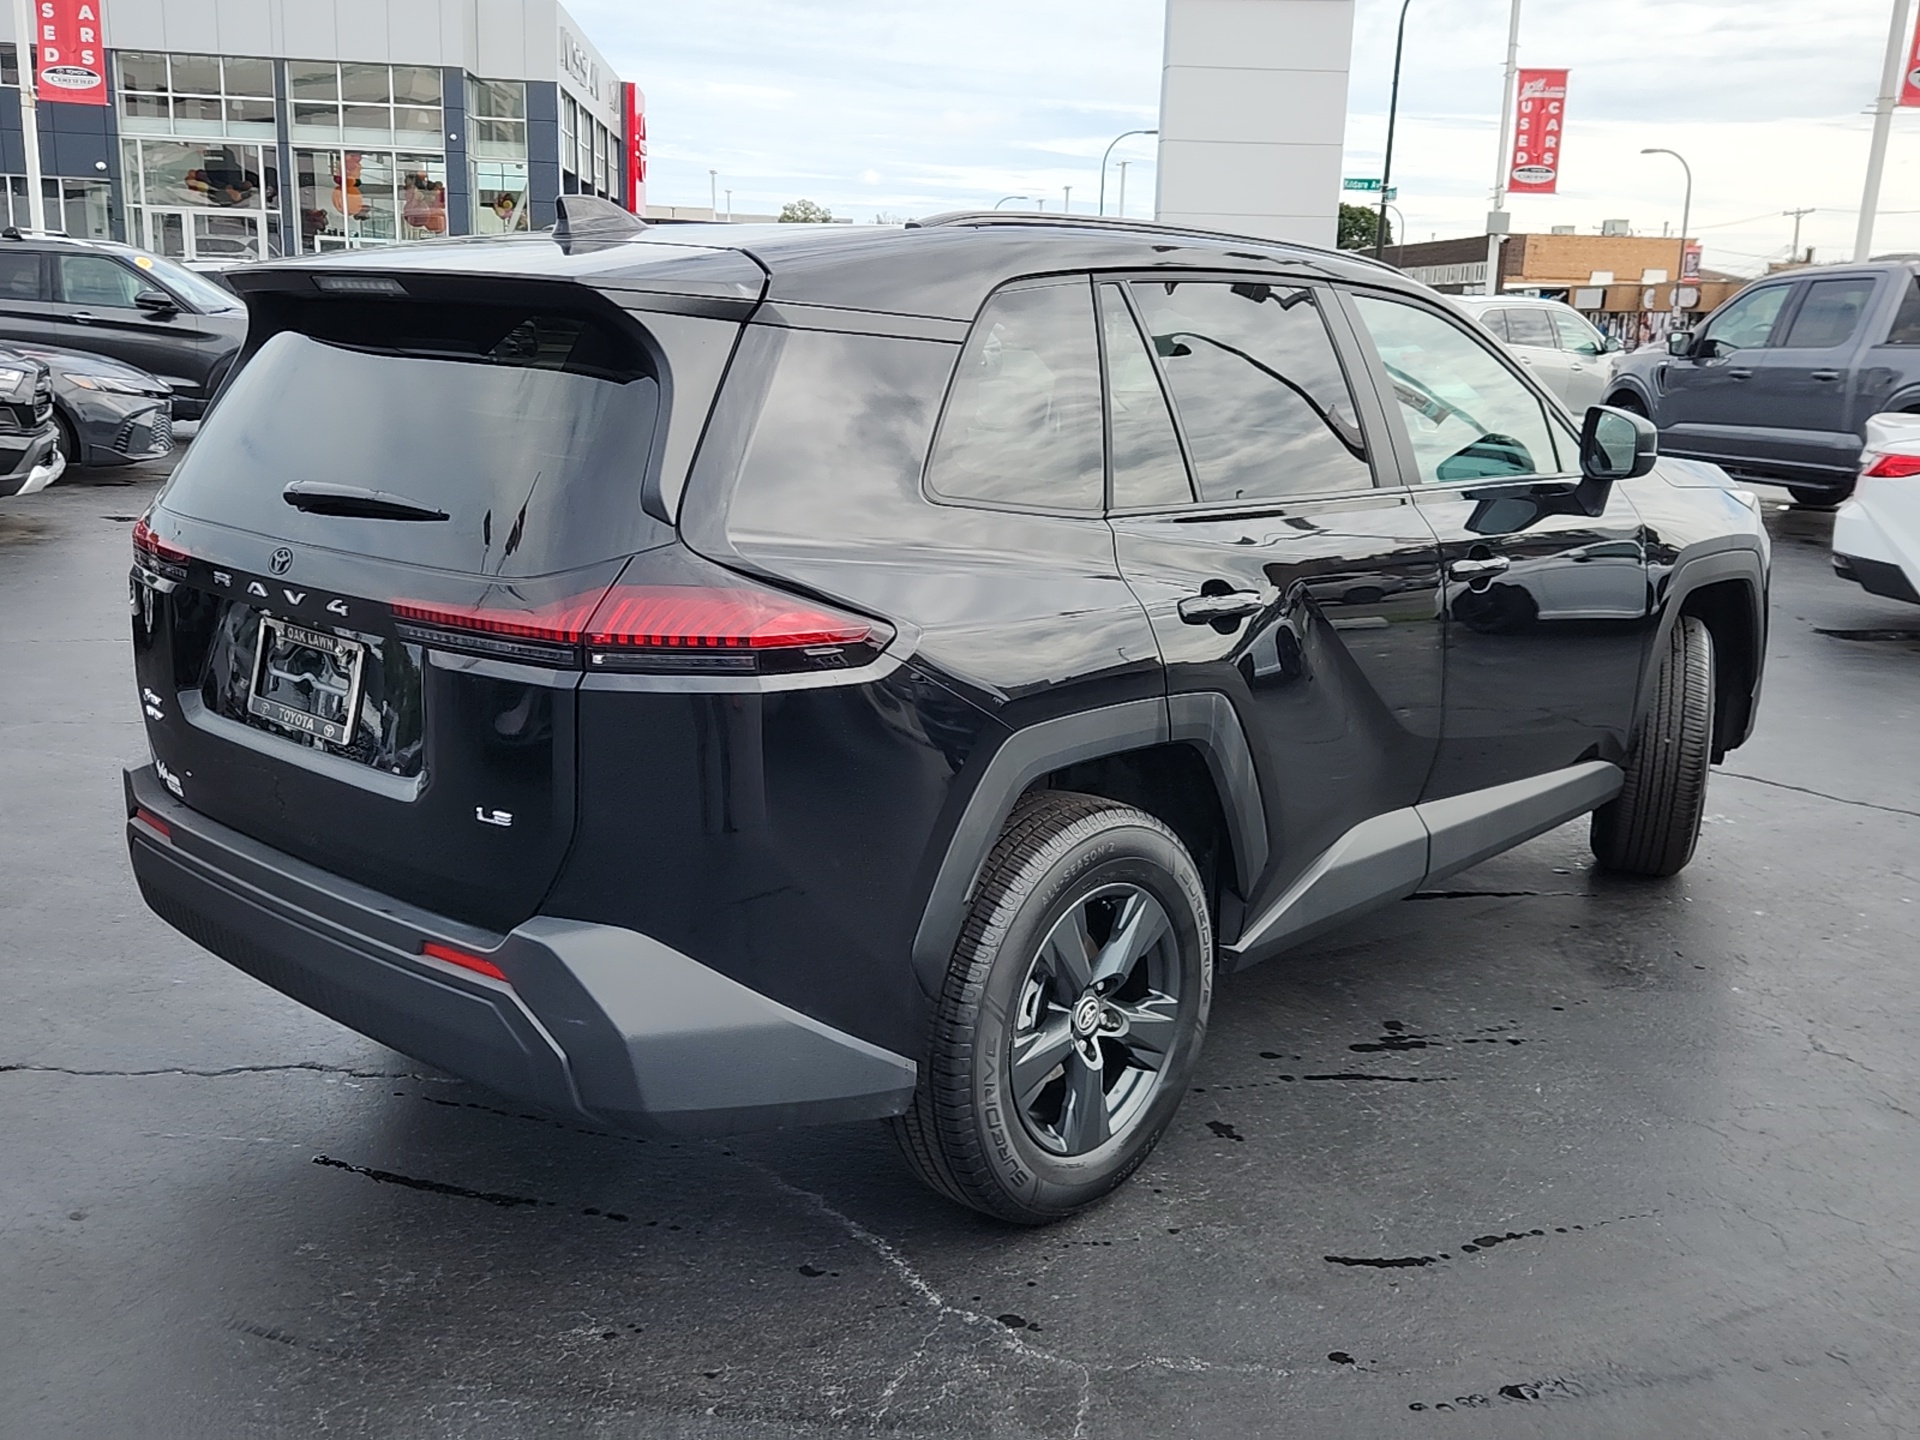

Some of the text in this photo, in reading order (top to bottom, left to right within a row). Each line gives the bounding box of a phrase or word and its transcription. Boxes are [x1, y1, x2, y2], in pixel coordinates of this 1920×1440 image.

[1516, 100, 1533, 164] USED
[1543, 101, 1561, 165] CARS
[213, 570, 349, 617] RAV4
[287, 627, 335, 651] OAK LAWN
[278, 707, 314, 731] TOYOTA
[475, 806, 514, 827] LE
[1041, 844, 1107, 907] ALL-SEASON
[983, 1036, 1030, 1188] SUREDRIVE
